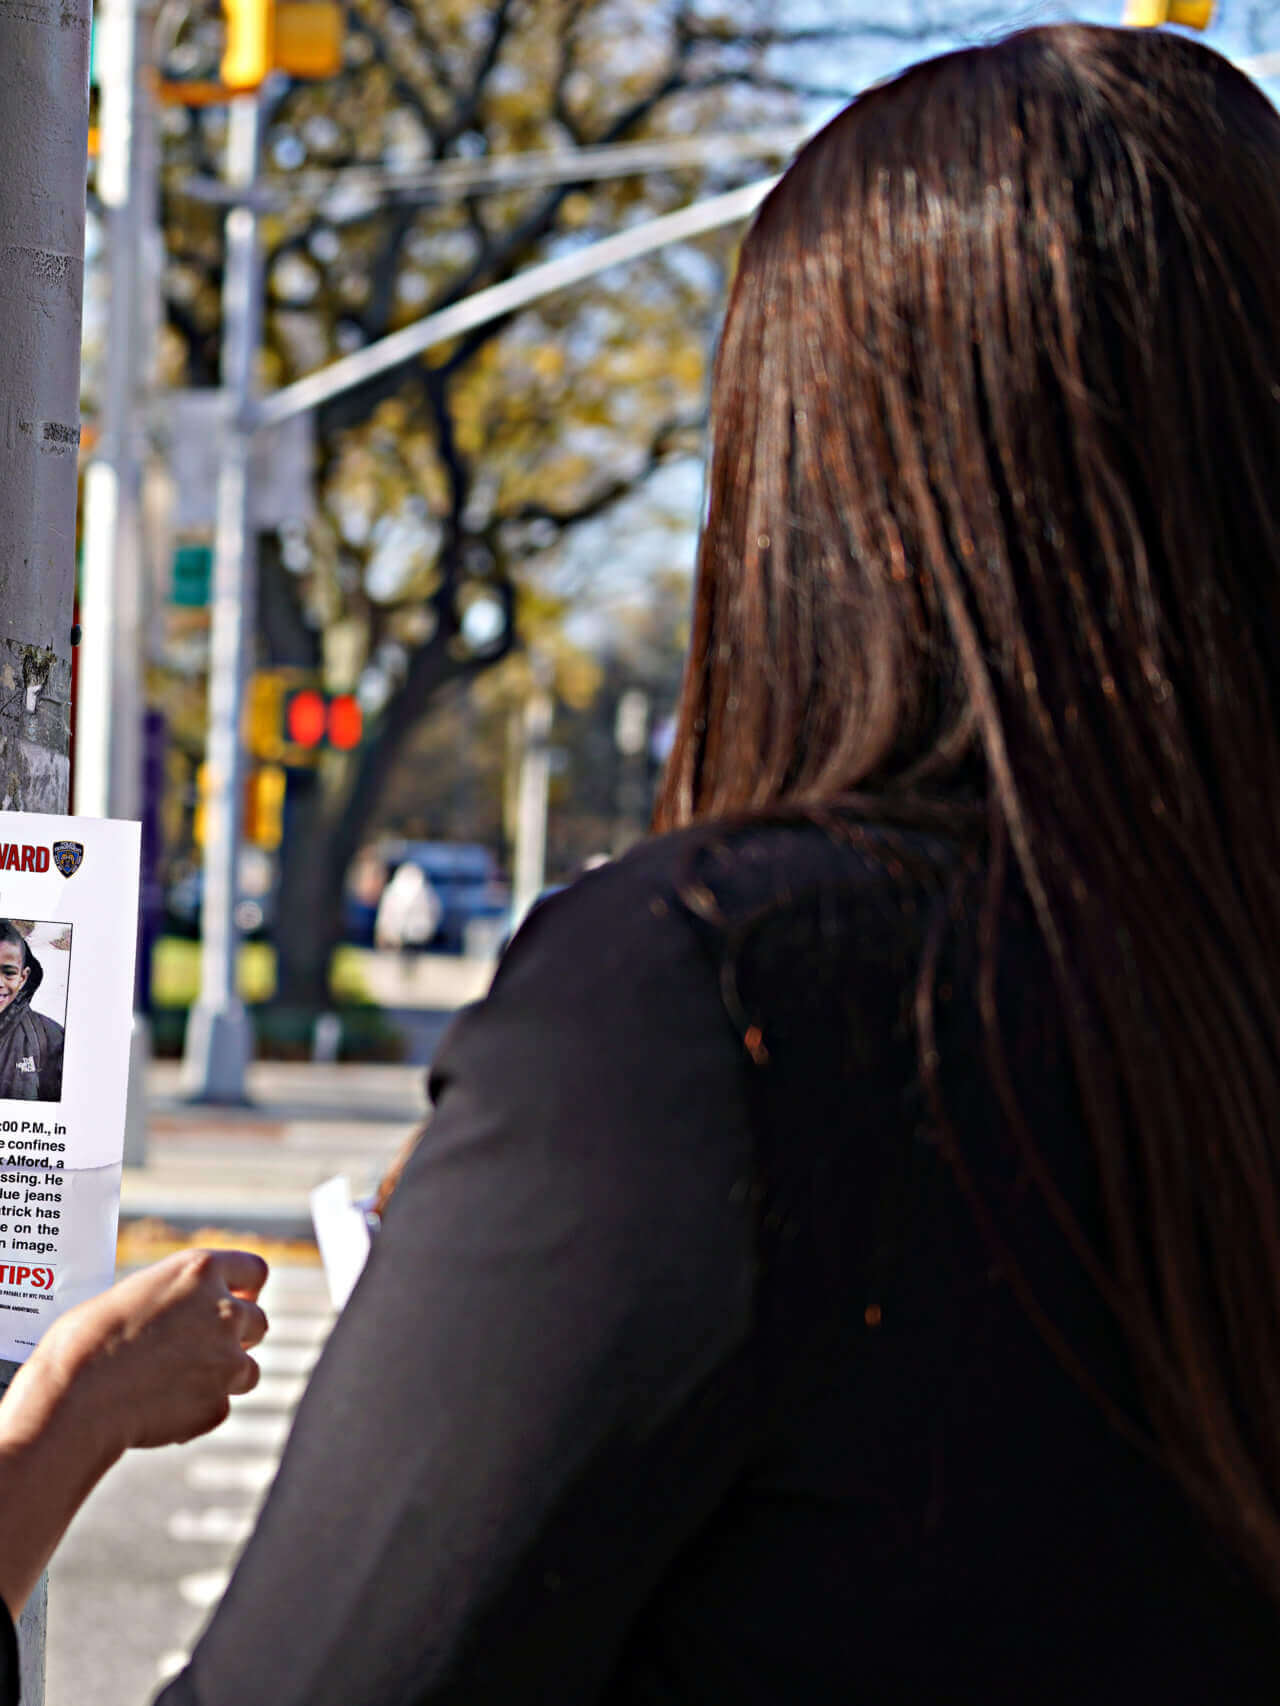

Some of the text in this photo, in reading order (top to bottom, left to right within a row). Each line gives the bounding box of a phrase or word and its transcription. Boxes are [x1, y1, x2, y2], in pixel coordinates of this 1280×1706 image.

[21, 1122, 51, 1136] P.M.,
[54, 1123, 66, 1134] in
[8, 1139, 65, 1152] confines
[6, 1155, 52, 1170] Alford,
[56, 1160, 64, 1169] a
[45, 1174, 63, 1186] He
[24, 1190, 62, 1203] jeans
[36, 1207, 60, 1219] has
[14, 1224, 31, 1234] on
[38, 1223, 59, 1235] the
[12, 1238, 57, 1253] image.
